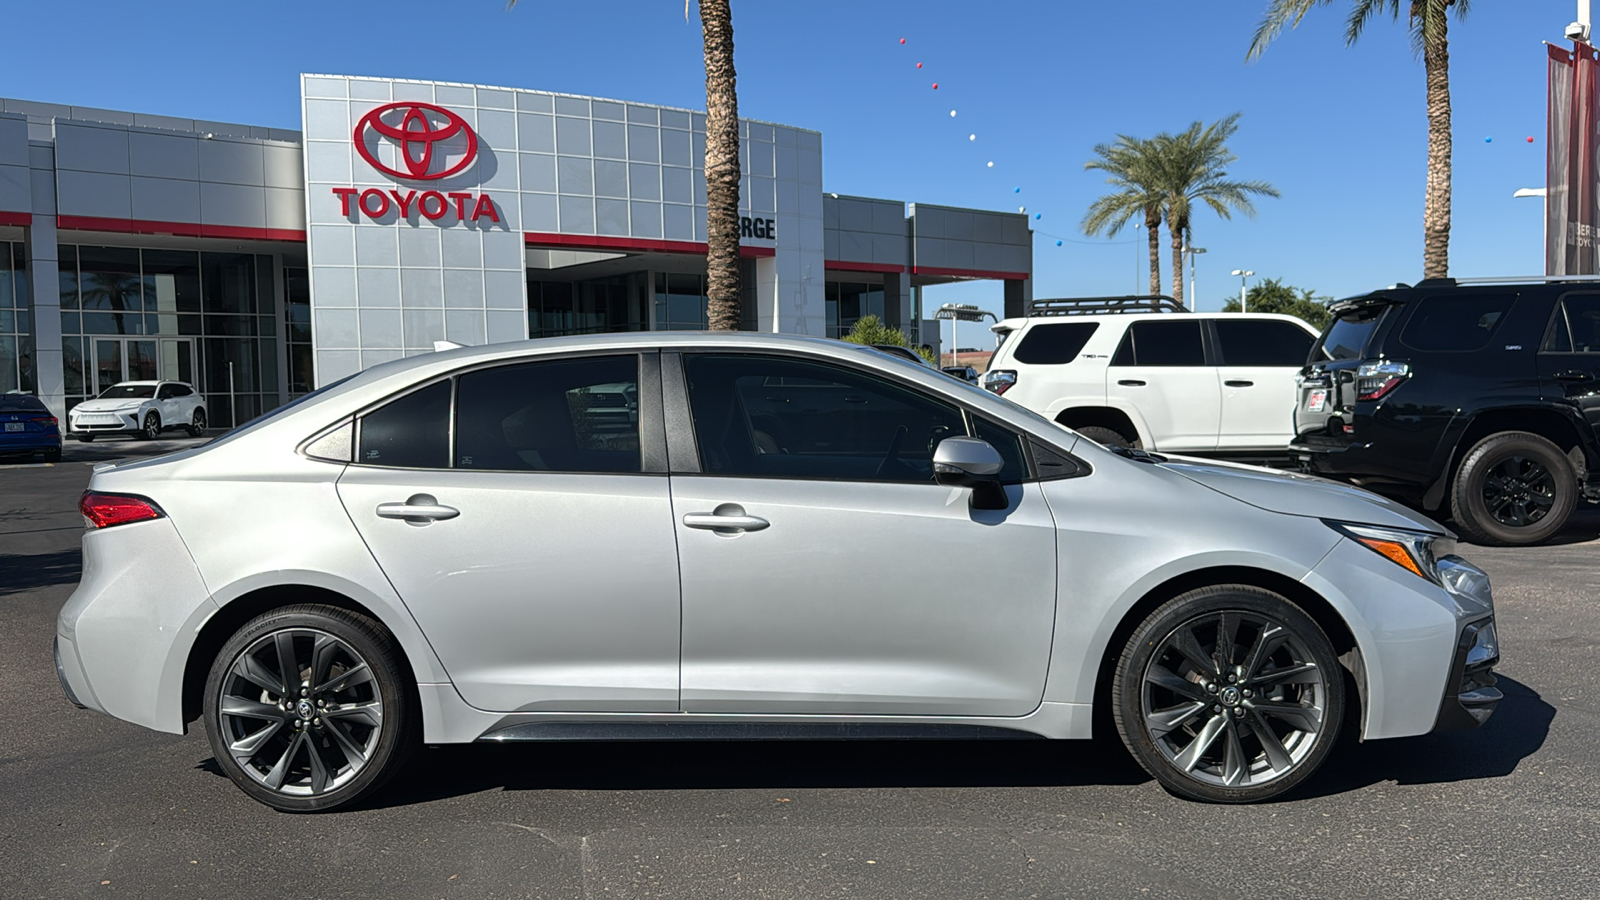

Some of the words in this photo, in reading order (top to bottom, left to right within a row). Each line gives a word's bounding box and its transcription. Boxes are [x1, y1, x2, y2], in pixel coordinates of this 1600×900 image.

[332, 187, 500, 222] TOYOTA
[740, 217, 775, 239] RGE
[243, 619, 277, 638] VELOCITY
